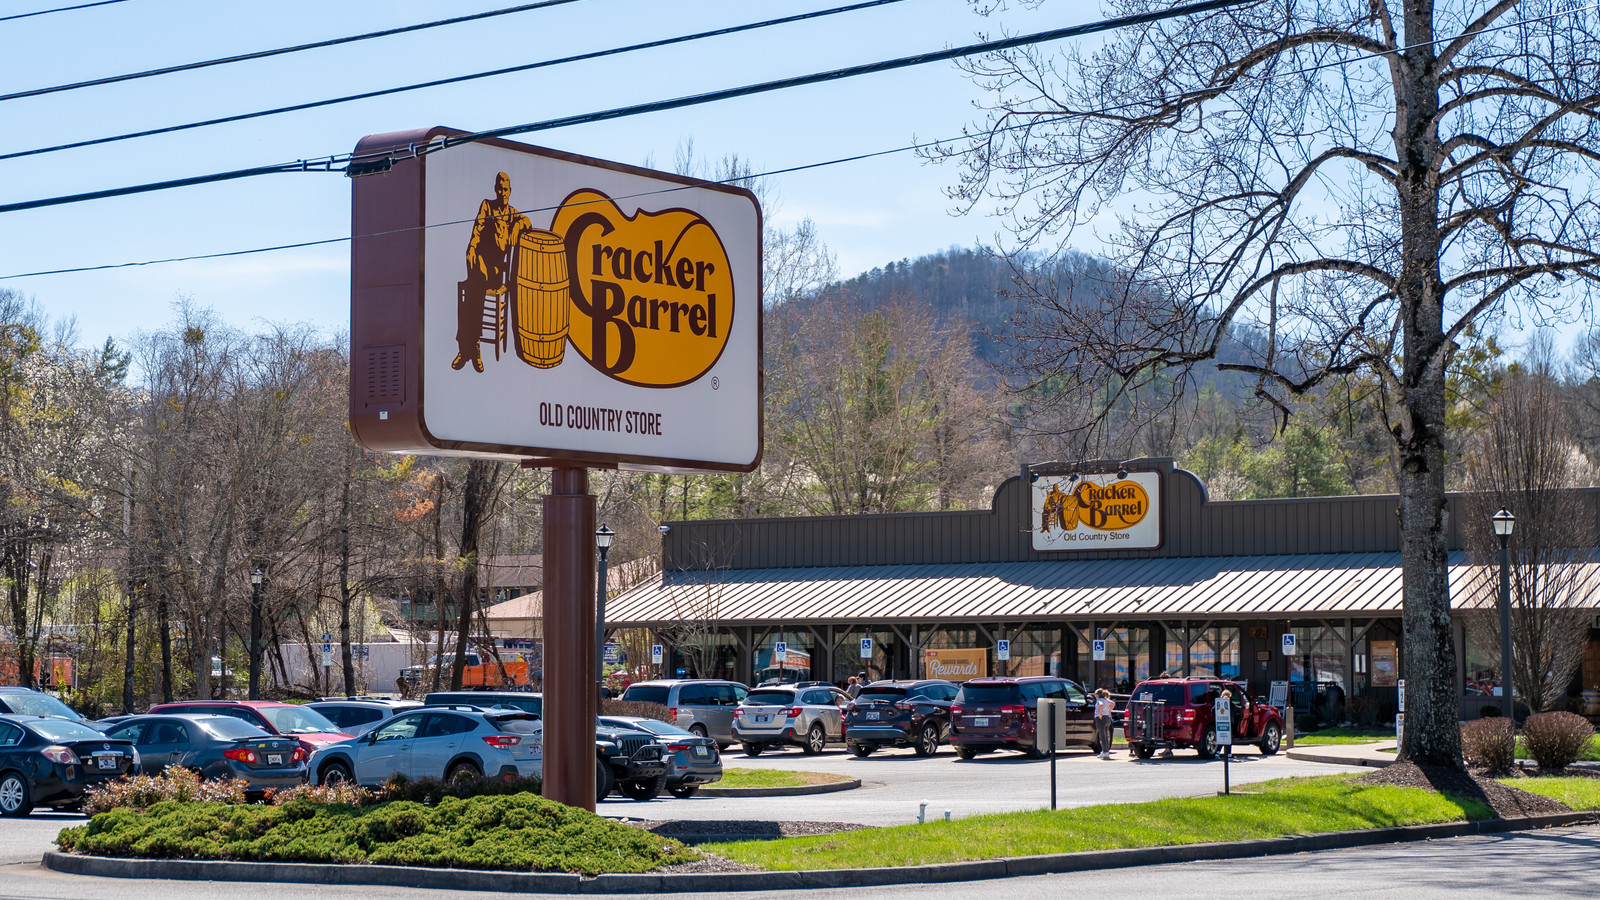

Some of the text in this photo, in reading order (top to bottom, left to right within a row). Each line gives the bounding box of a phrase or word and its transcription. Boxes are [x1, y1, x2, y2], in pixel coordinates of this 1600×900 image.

[564, 212, 715, 318] Cracker
[591, 279, 718, 375] Barrel
[539, 402, 662, 436] OLD COUNTRY STORE
[1074, 483, 1136, 508] Cracker
[1089, 500, 1142, 528] Barrel
[1064, 532, 1130, 542] Old Country Store
